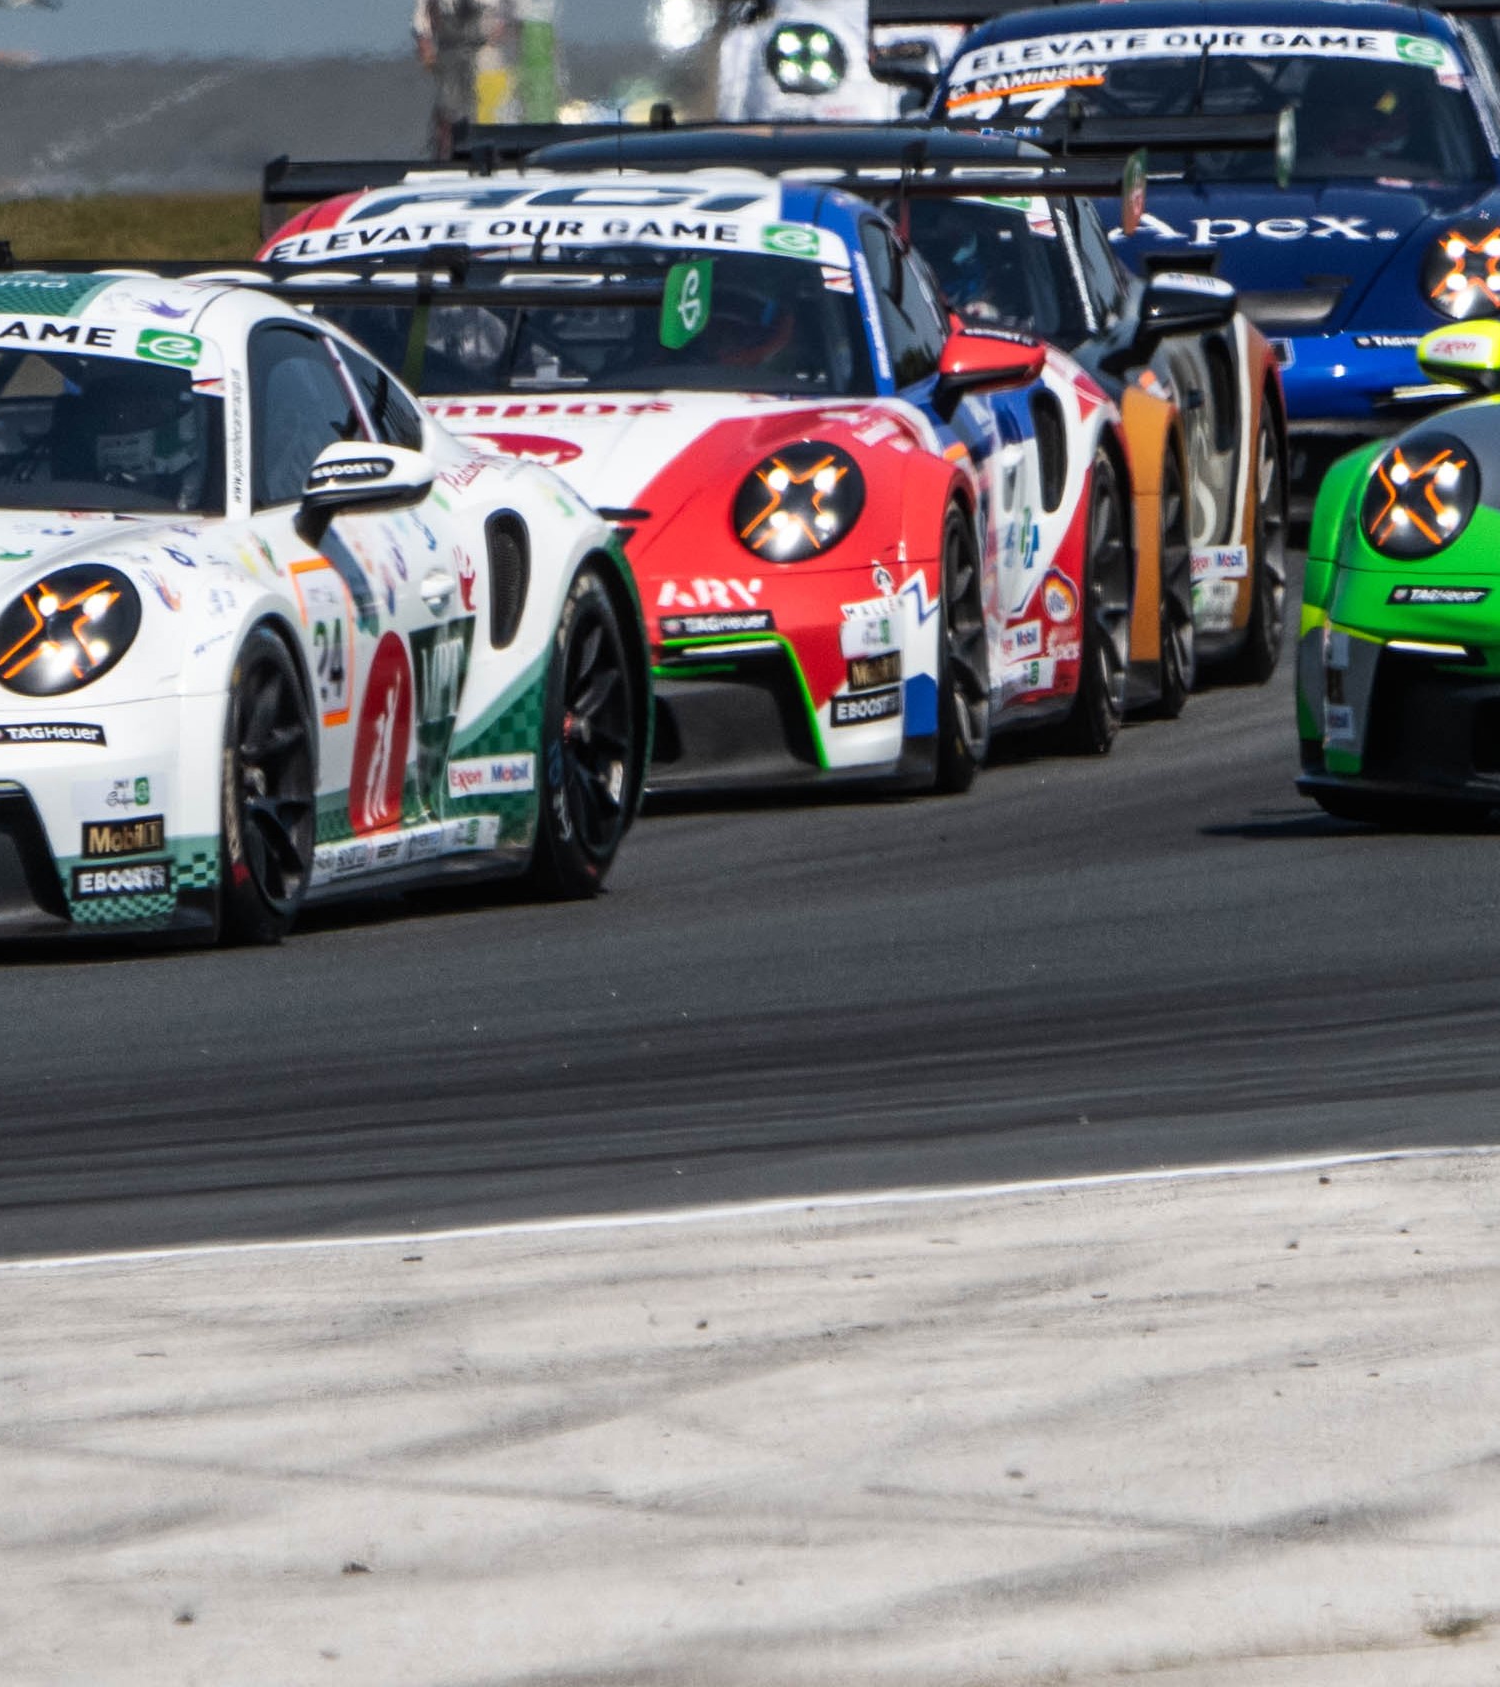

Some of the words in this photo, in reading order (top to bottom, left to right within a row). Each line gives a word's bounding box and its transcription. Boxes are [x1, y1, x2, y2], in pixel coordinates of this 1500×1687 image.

[971, 32, 1148, 72] ELEVATE
[1164, 32, 1246, 48] OUR
[1261, 33, 1379, 51] GAME
[271, 221, 468, 263] ELEVATE
[488, 220, 584, 238] OUR
[602, 221, 740, 243] GAME
[491, 762, 529, 783] Mobil
[87, 824, 148, 856] Mobil
